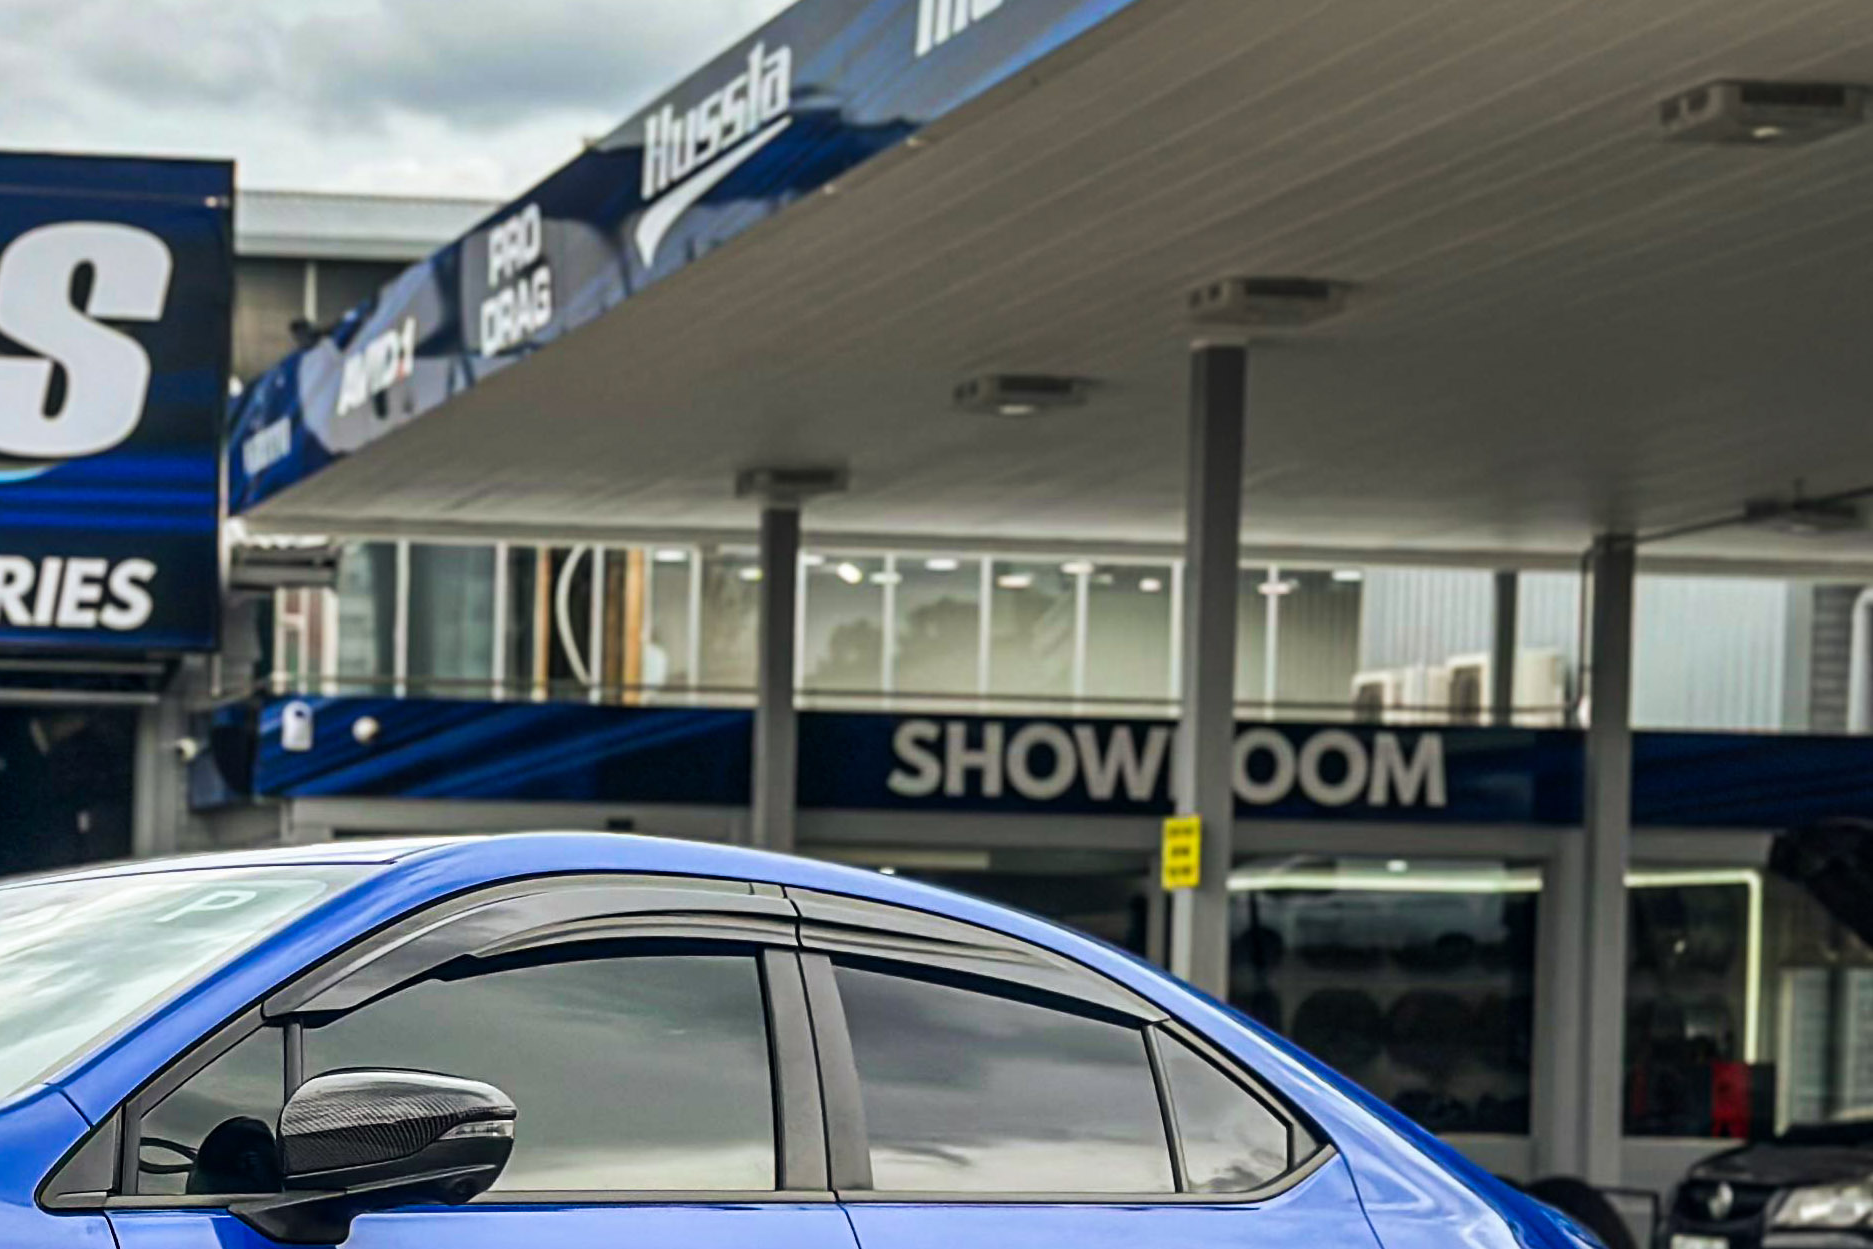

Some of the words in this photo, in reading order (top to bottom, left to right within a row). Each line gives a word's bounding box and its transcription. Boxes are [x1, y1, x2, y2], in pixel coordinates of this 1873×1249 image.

[640, 41, 792, 201] Hussla
[488, 203, 542, 289] PRO
[480, 264, 552, 359] DRAG
[887, 719, 1447, 807] SHOWOOM
